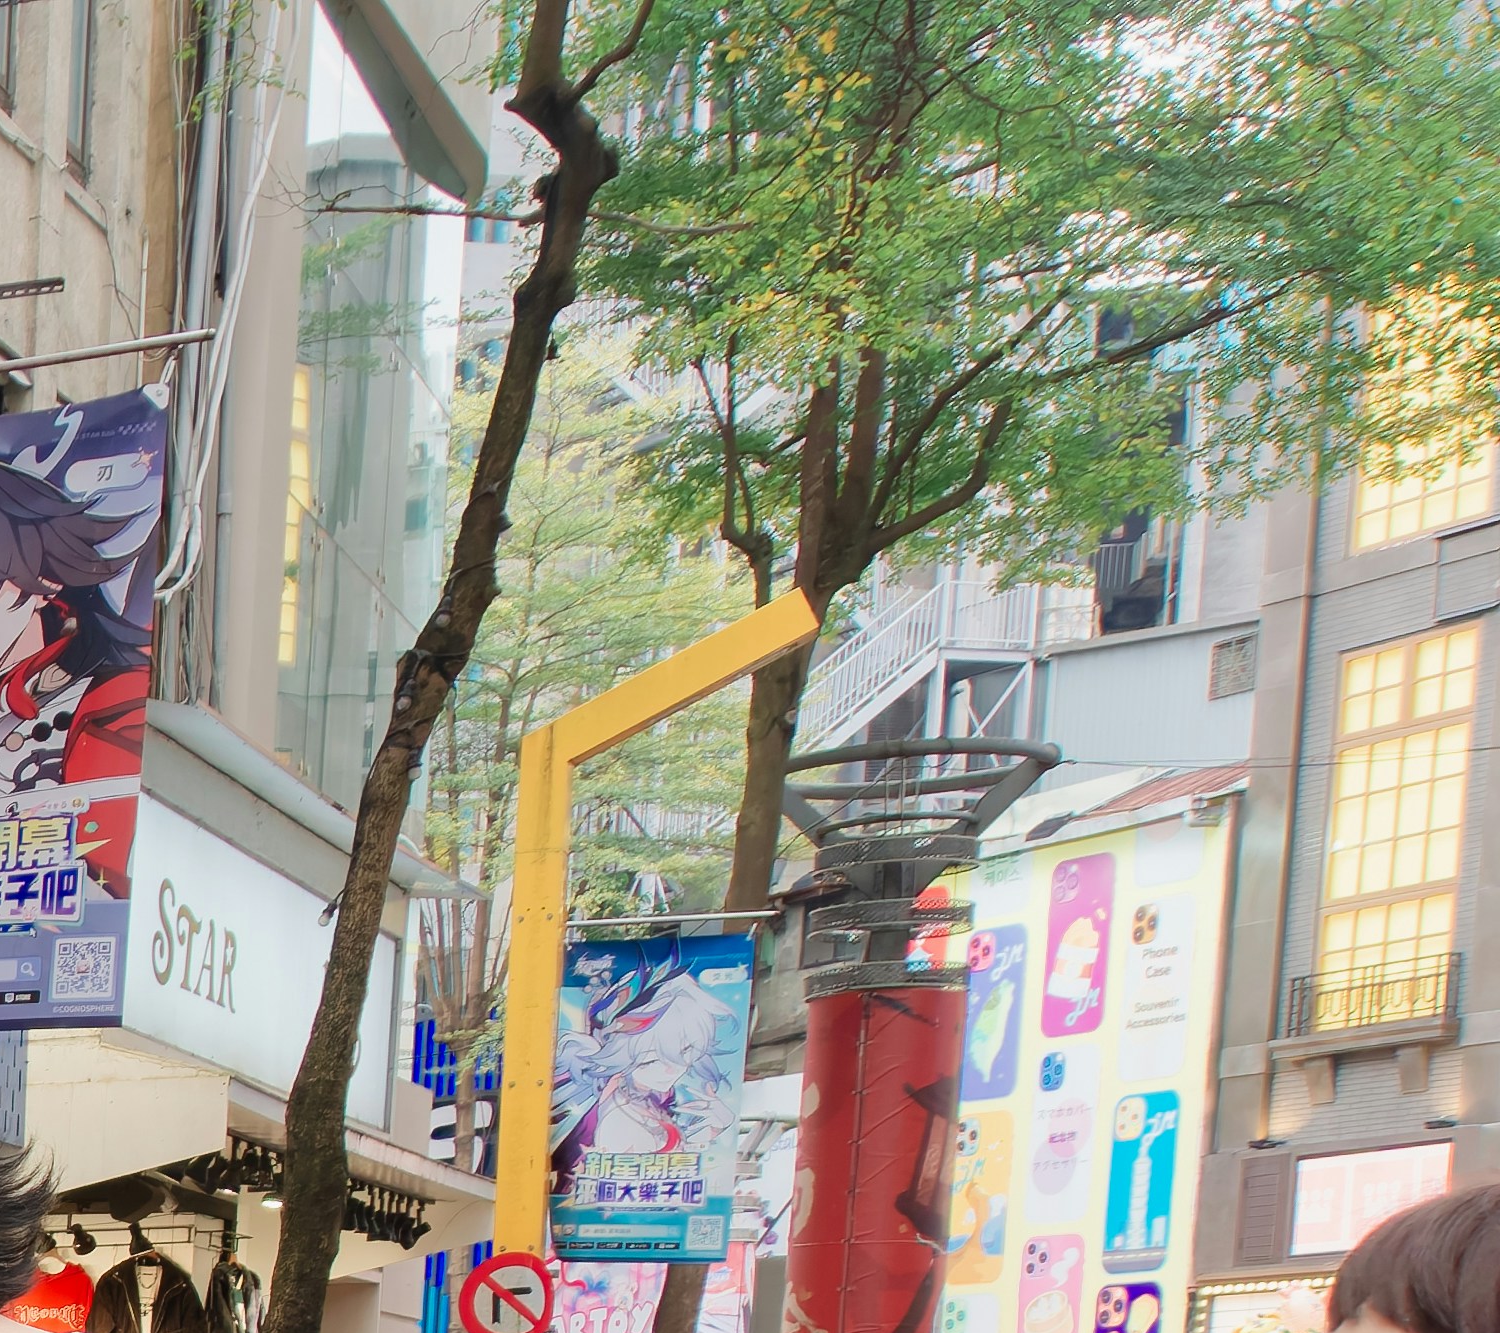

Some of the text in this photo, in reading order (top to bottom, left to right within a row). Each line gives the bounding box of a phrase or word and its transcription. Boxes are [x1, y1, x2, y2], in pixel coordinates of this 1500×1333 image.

[152, 878, 238, 1014] STAR
[1142, 945, 1179, 961] Phone
[1145, 966, 1172, 980] Case
[1134, 997, 1180, 1014] Souvenir
[1125, 1012, 1186, 1030] Accessories
[585, 1152, 700, 1180] 新星開幕
[575, 1178, 704, 1205] 來個大樂子吧
